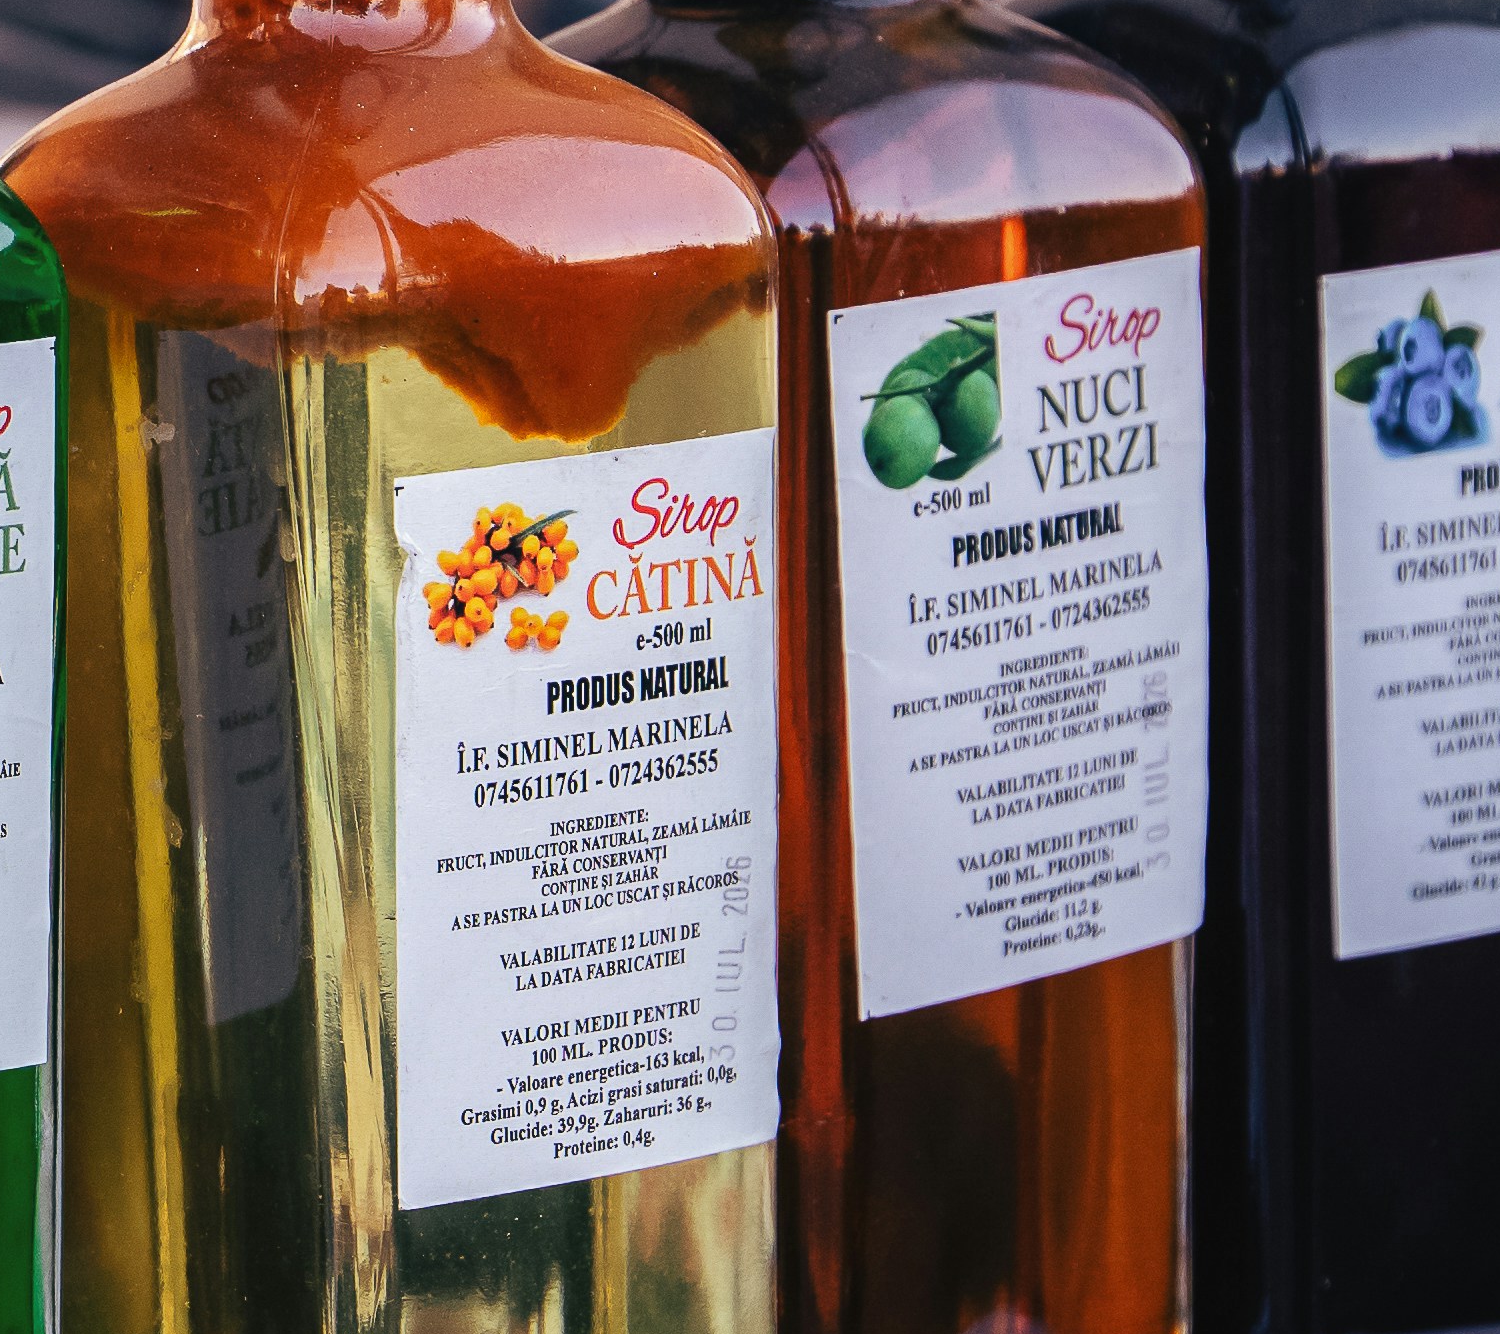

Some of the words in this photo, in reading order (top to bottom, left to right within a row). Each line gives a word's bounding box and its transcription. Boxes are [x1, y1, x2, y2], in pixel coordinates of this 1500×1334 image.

[1043, 293, 1160, 364] Sirop
[1036, 364, 1145, 433] NUCI
[1026, 421, 1156, 493] VERZI
[612, 477, 739, 550] Sirop
[968, 481, 990, 507] ml
[952, 521, 1034, 568] PRODUS
[1039, 501, 1123, 550] NATURAL
[586, 535, 763, 620] CĂTINĂ
[947, 576, 1044, 617] SIMINEL
[1049, 549, 1162, 596] MARINELA
[689, 617, 711, 643] ml
[926, 613, 1031, 656] 0745611761
[1051, 586, 1149, 629] 0724362555
[546, 670, 634, 715] PRODUS
[640, 655, 728, 701] NATURAL
[456, 741, 489, 774] Î.F.
[496, 731, 602, 768] SIMINEL
[607, 710, 732, 752] MARINELA
[474, 768, 588, 808] 0745611761
[609, 748, 717, 788] 0724362555
[437, 853, 486, 873] FRUCT,
[489, 839, 578, 865] INDULCITOR
[581, 828, 648, 852] NATURAL,
[651, 816, 698, 840] ZEAMĂ
[701, 808, 751, 832] LĂMÂIE
[549, 808, 648, 836] INGREDIENTE:
[531, 857, 568, 879] FĂRĂ
[615, 865, 658, 885] ZAHĂR
[463, 913, 480, 928] SE
[483, 904, 537, 926] PASTRA
[541, 900, 559, 917] LA
[561, 897, 581, 914] UN
[584, 892, 613, 910] LOC
[616, 884, 659, 905] USCAT
[677, 870, 739, 895] RĂCOROS
[499, 936, 617, 969] VALABILITATE
[621, 933, 635, 951] 12
[639, 926, 675, 947] LUNI
[679, 922, 700, 940] DE
[515, 973, 537, 991] LA
[540, 966, 582, 987] DATA
[586, 947, 684, 980] FABRICATIEI
[500, 1020, 569, 1046] VALORI
[574, 1010, 628, 1035] MEDII
[632, 997, 700, 1025] PENTRU
[532, 1046, 556, 1066] 100
[561, 1042, 593, 1061] ML.
[597, 1027, 672, 1055] PRODUS:
[460, 1100, 520, 1125] Grasimi
[525, 1096, 546, 1116] 0,9
[550, 1099, 563, 1115] g,
[566, 1086, 603, 1108] Acizi
[607, 1079, 641, 1105] grasi
[645, 1069, 702, 1094] saturati:
[707, 1064, 736, 1083] 0,0g,
[506, 1074, 563, 1094] Valoare
[567, 1051, 668, 1084] energetica-163
[673, 1045, 704, 1065] kcal,
[490, 1121, 552, 1144] Glucide:
[557, 1114, 599, 1133] 39,9g.
[603, 1098, 672, 1125] Zaharuri:
[676, 1094, 692, 1112] 36
[553, 1135, 618, 1159] Proteine:
[622, 1128, 655, 1148] 0,4g.
